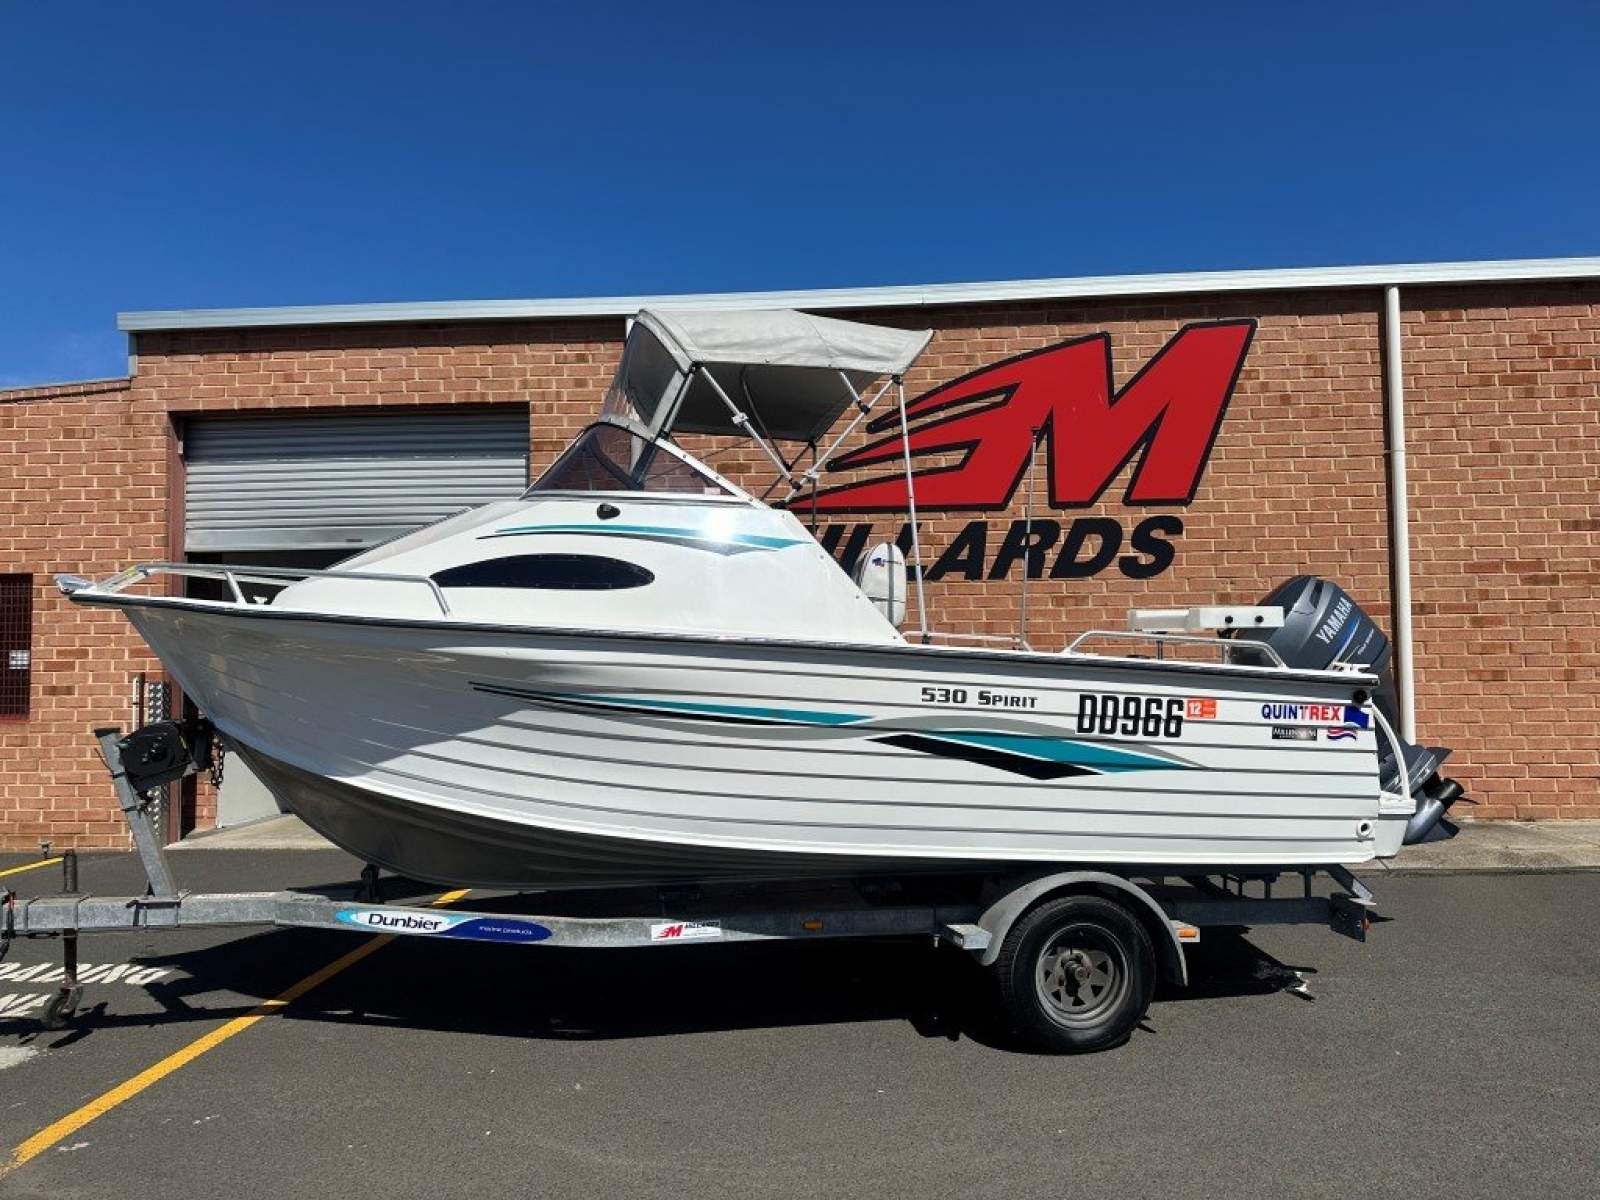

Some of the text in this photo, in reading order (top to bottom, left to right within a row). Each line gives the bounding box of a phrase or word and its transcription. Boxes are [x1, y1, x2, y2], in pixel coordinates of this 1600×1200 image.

[806, 516, 1184, 580] ILLARDS
[1315, 597, 1353, 645] YAMAHA
[921, 687, 968, 704] 530
[1077, 694, 1184, 738] DD966
[1261, 704, 1341, 721] QUINTREX
[367, 913, 443, 931] Dunbier
